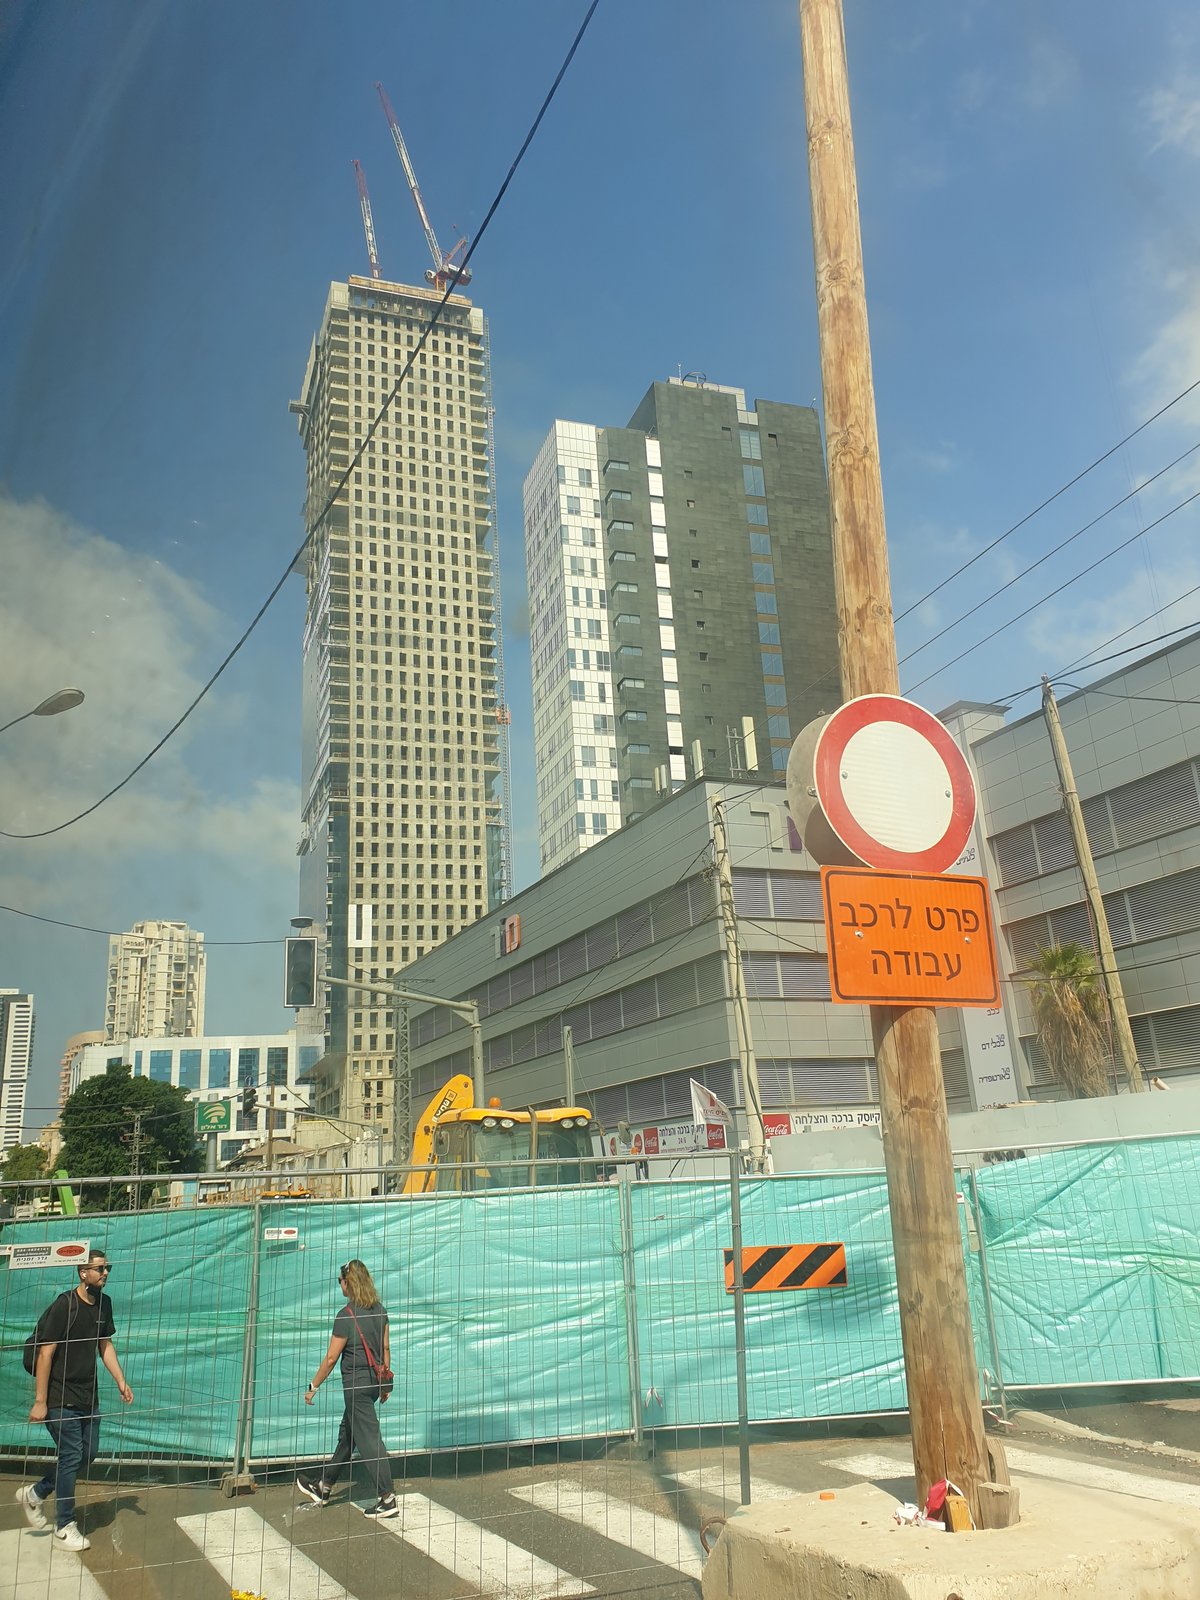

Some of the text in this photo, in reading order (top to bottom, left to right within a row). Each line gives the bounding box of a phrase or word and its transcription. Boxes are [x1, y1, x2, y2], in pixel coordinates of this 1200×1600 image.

[839, 898, 980, 933] פרט לרכב
[871, 949, 962, 981] עבודה
[795, 1112, 881, 1125] קיוסק ברכה והצלחה
